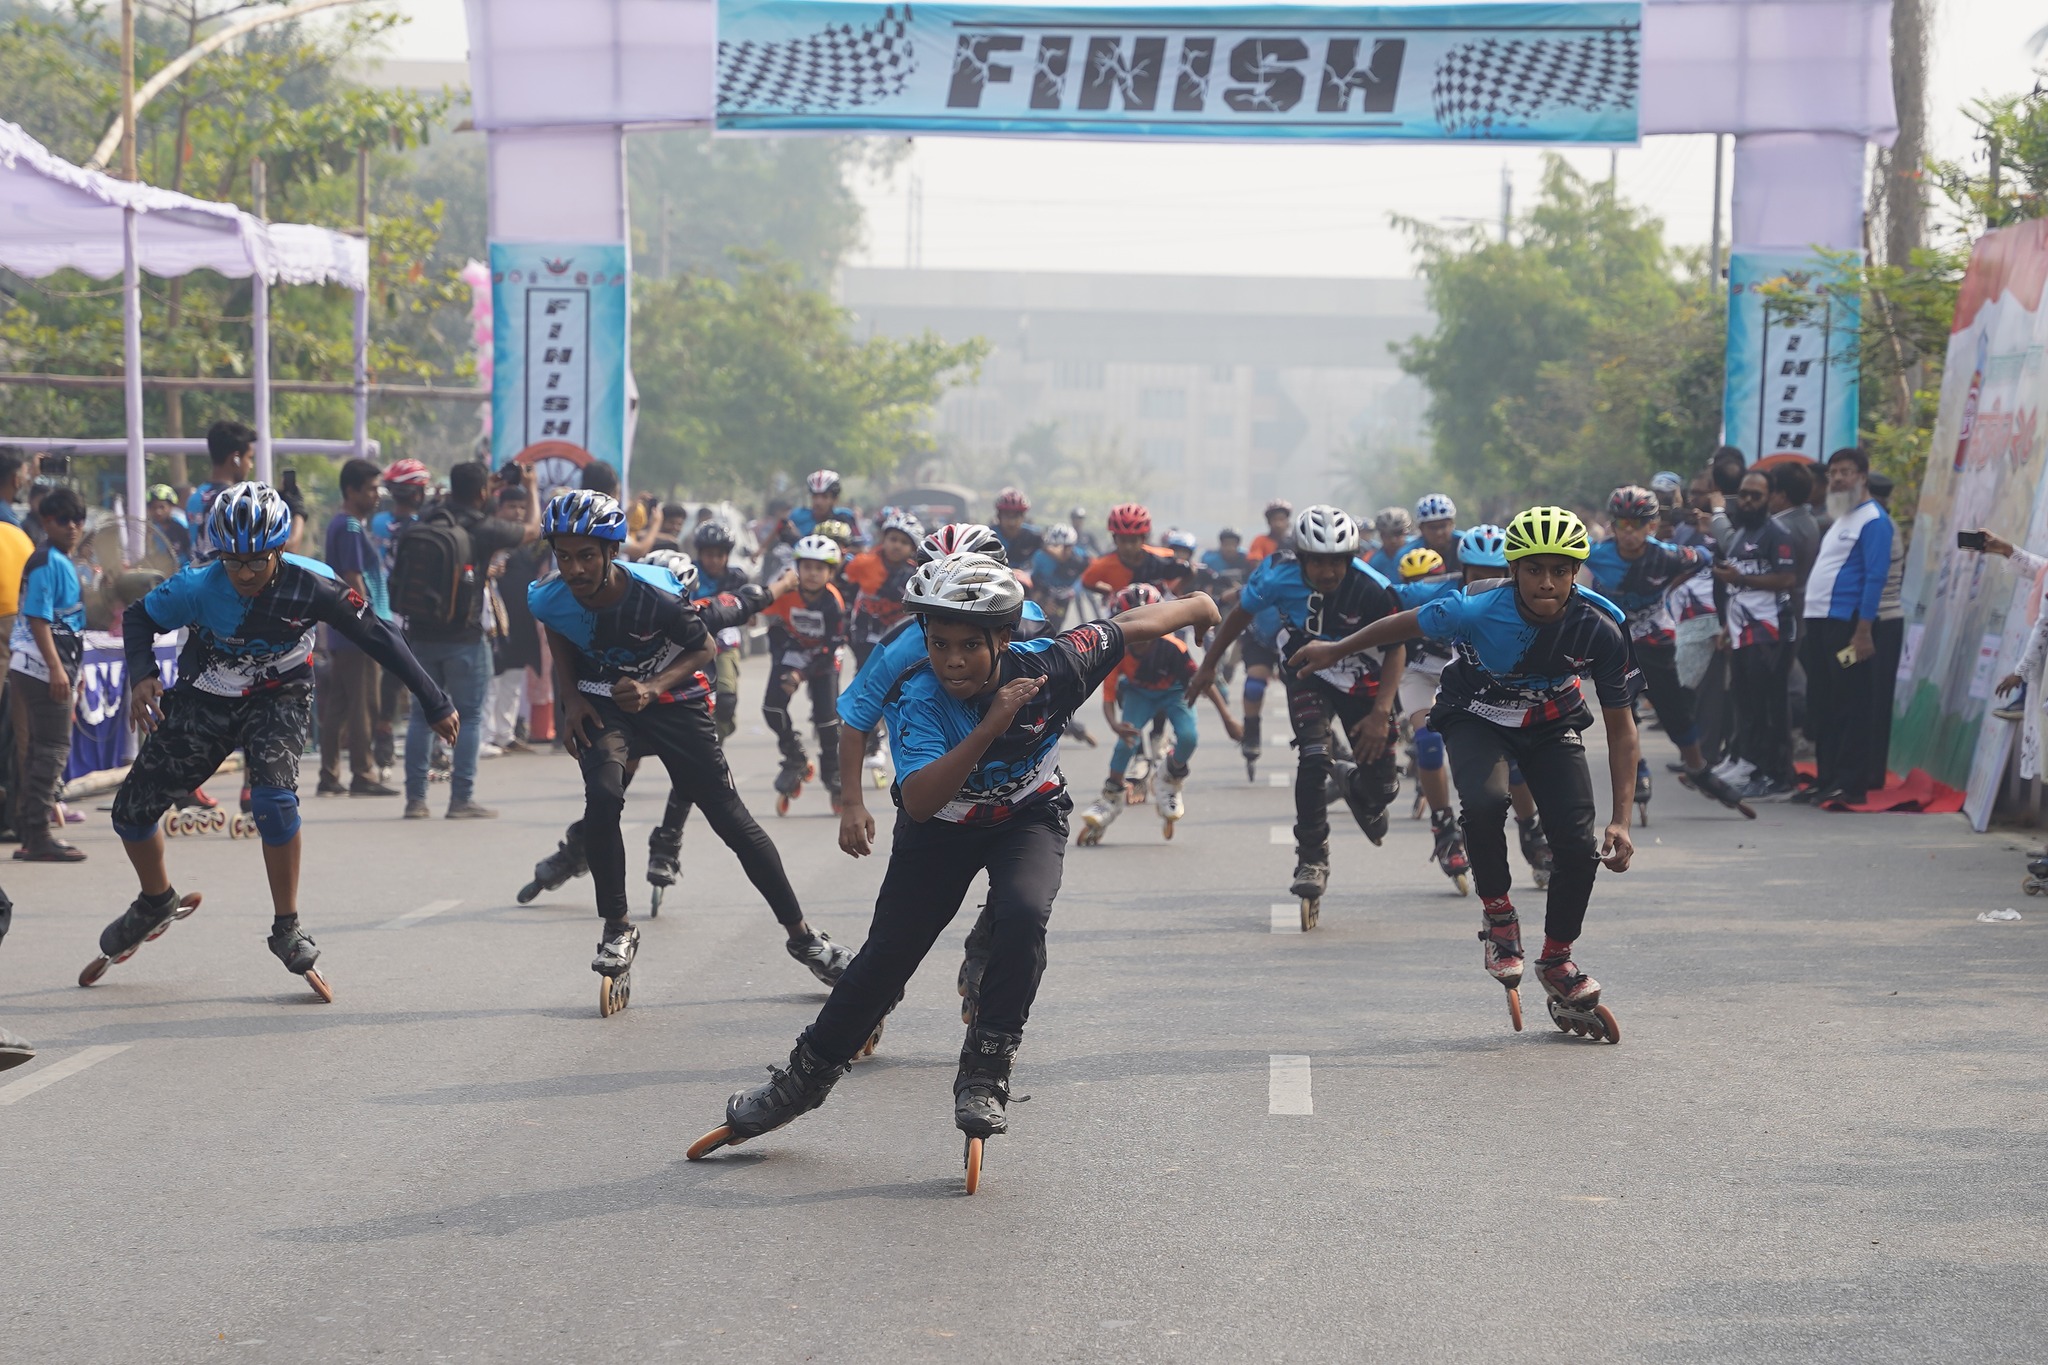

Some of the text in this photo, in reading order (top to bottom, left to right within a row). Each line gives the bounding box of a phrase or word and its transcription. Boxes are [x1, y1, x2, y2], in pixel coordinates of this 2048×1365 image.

[946, 33, 1407, 113] FINISH
[543, 298, 572, 436] FINISH
[1776, 317, 1812, 449] INISH
